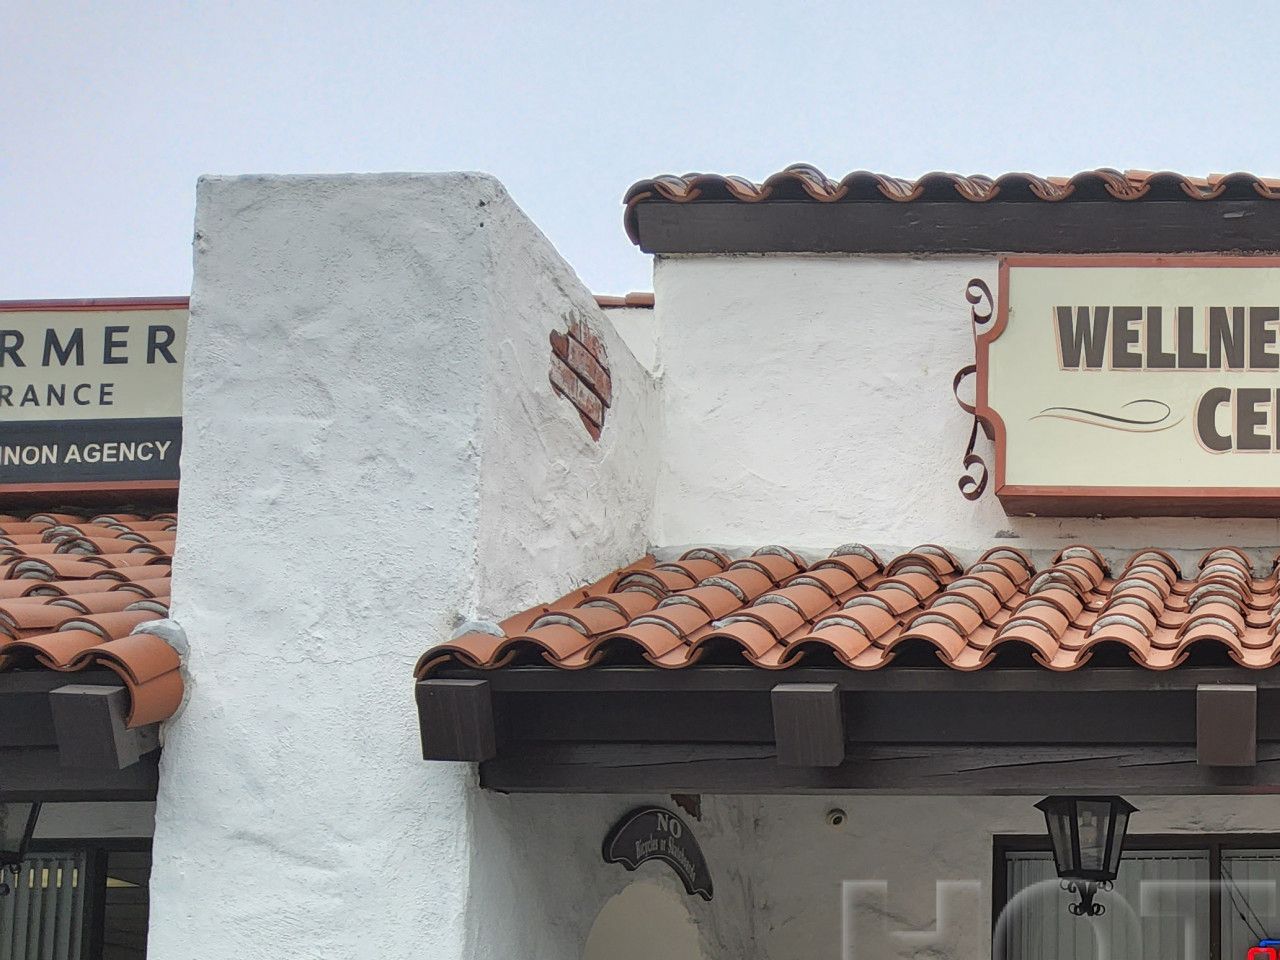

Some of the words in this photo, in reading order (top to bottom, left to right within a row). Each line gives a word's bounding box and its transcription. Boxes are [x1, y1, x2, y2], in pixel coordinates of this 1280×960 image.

[0, 325, 178, 367] RMER
[0, 383, 114, 407] RANCE
[0, 445, 57, 466] NON
[64, 440, 172, 464] AGENCY
[657, 813, 682, 839] NO
